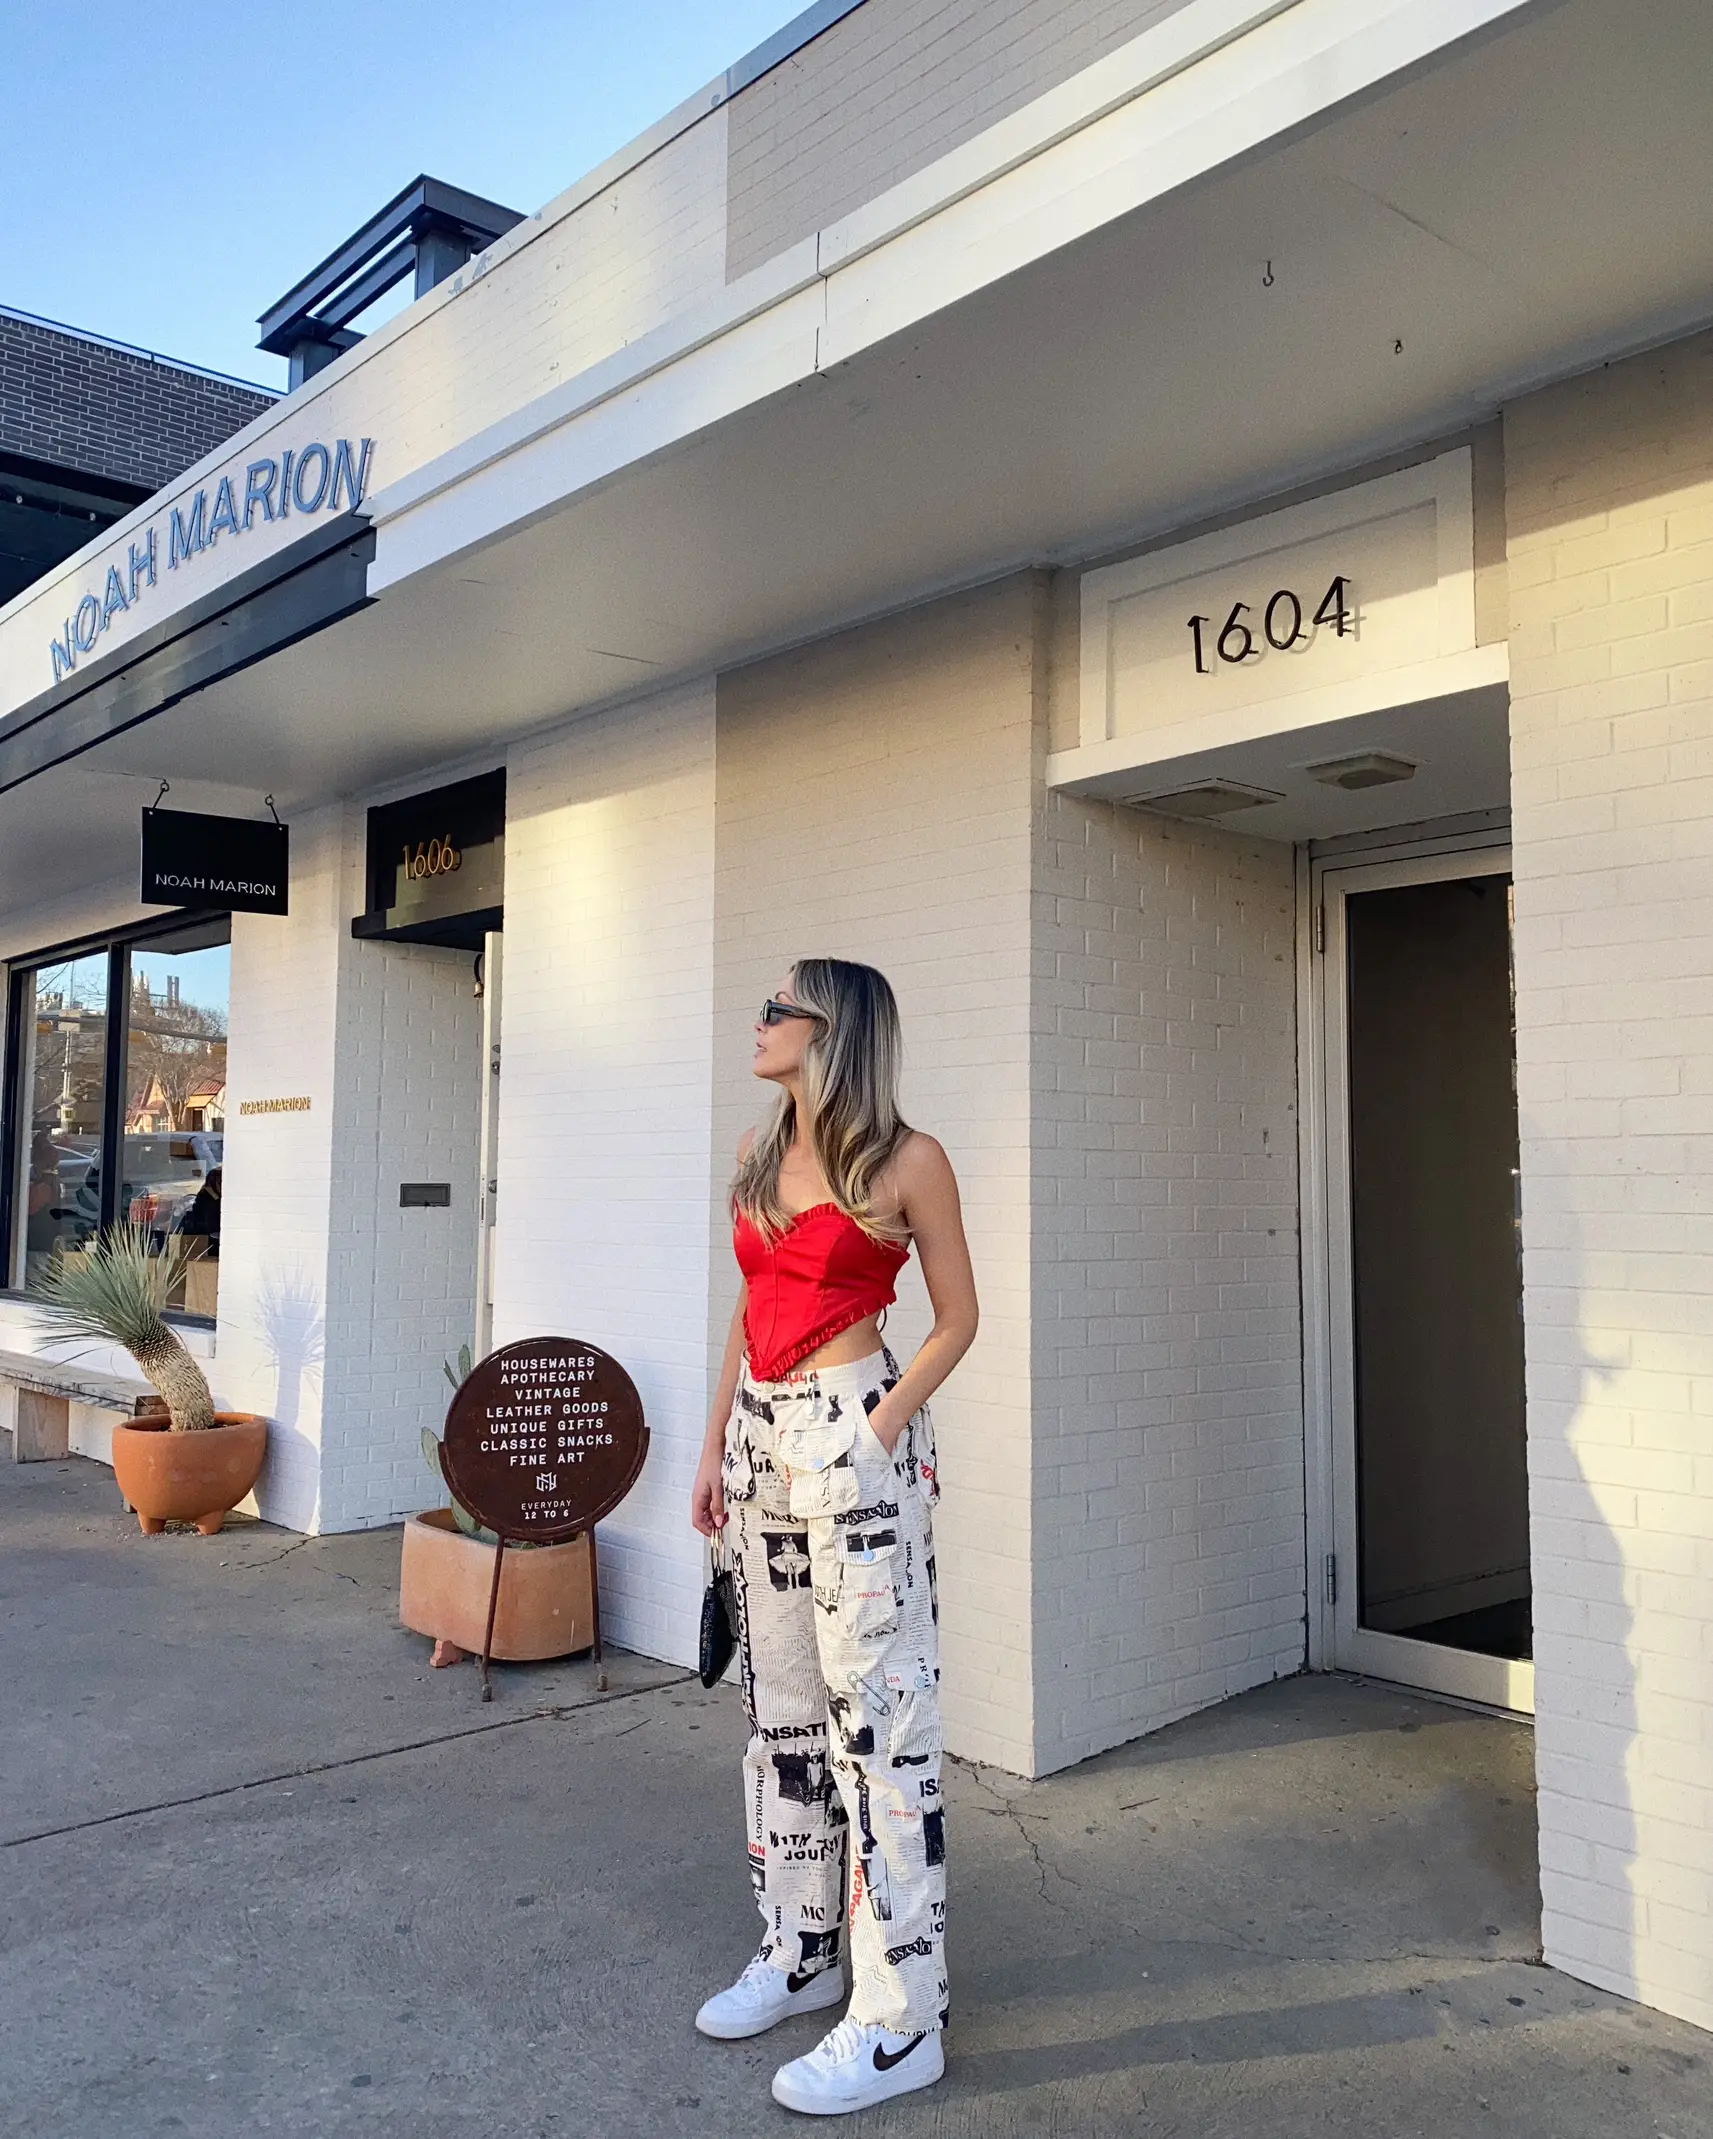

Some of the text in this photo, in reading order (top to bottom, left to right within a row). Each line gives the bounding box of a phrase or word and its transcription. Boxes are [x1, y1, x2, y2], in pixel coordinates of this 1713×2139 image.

[50, 438, 373, 683] NOAH MARION
[1187, 576, 1350, 673] 1604
[402, 833, 456, 880] 1606
[155, 873, 277, 896] NOAH MARION
[239, 1096, 311, 1115] NOAH MARION
[501, 1356, 595, 1371] HOUSEWARES
[500, 1370, 595, 1385] APOTHECARY
[515, 1387, 581, 1400] VINTAGE
[486, 1402, 609, 1419] LEATHER GOODS
[490, 1418, 604, 1434] UNIQUE GIFTS
[480, 1434, 613, 1452] CLASSIC SNACKS
[510, 1452, 585, 1467] FINE ART
[521, 1499, 572, 1511] EVERYDAY
[524, 1510, 569, 1520] 12 TO 6
